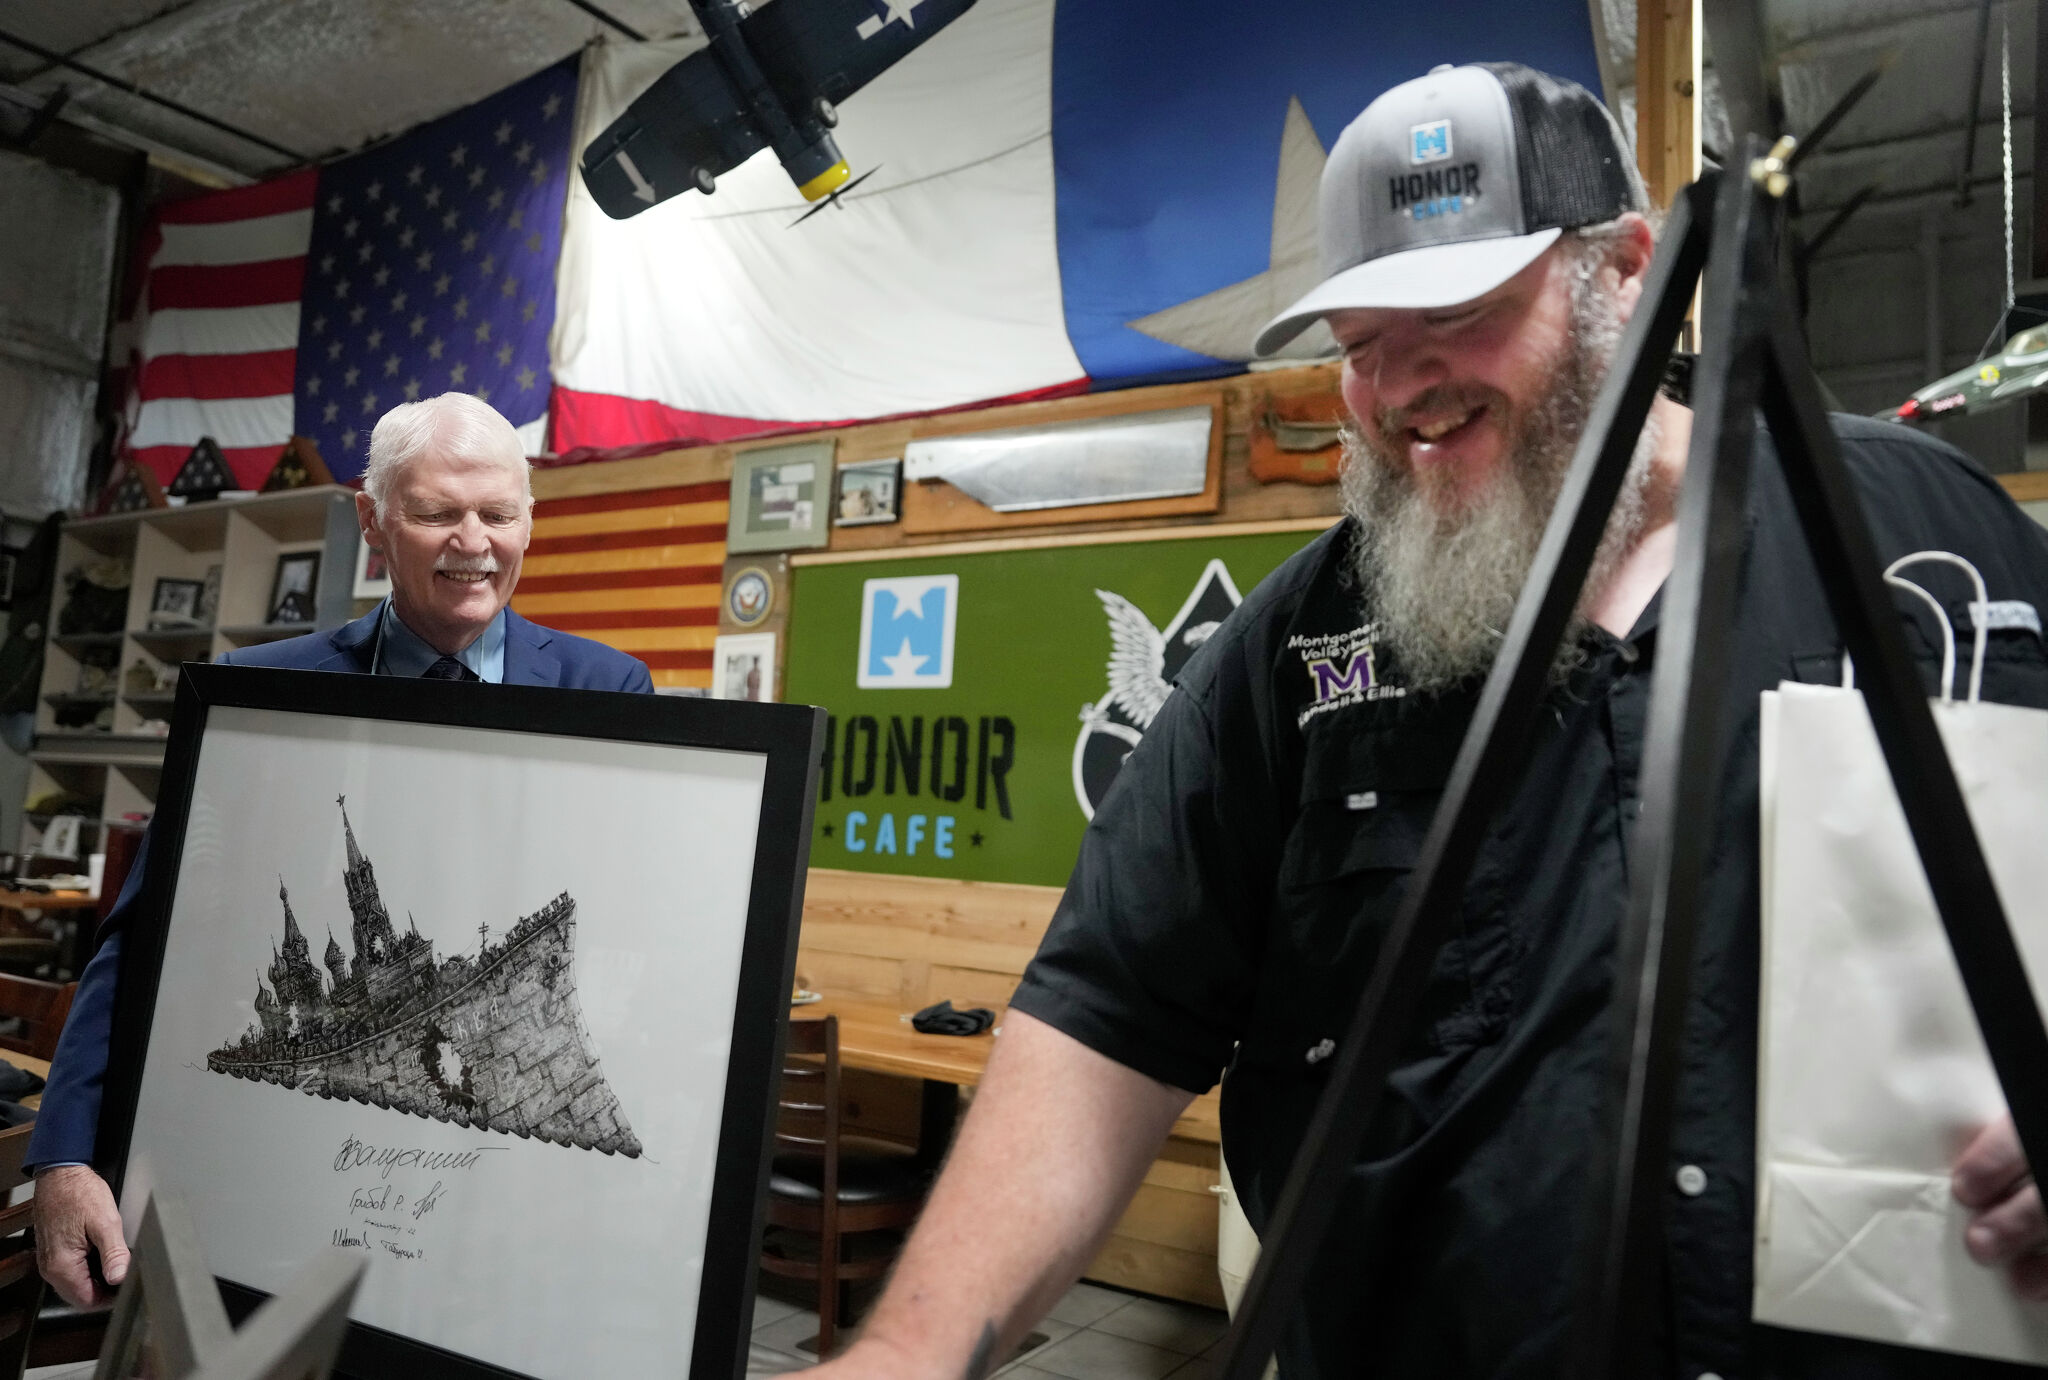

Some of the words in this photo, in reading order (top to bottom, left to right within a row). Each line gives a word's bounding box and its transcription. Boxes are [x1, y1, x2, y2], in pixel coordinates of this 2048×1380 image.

[1388, 162, 1482, 210] HONOR
[1301, 630, 1380, 662] Volleyball
[844, 810, 956, 860] CAFE
